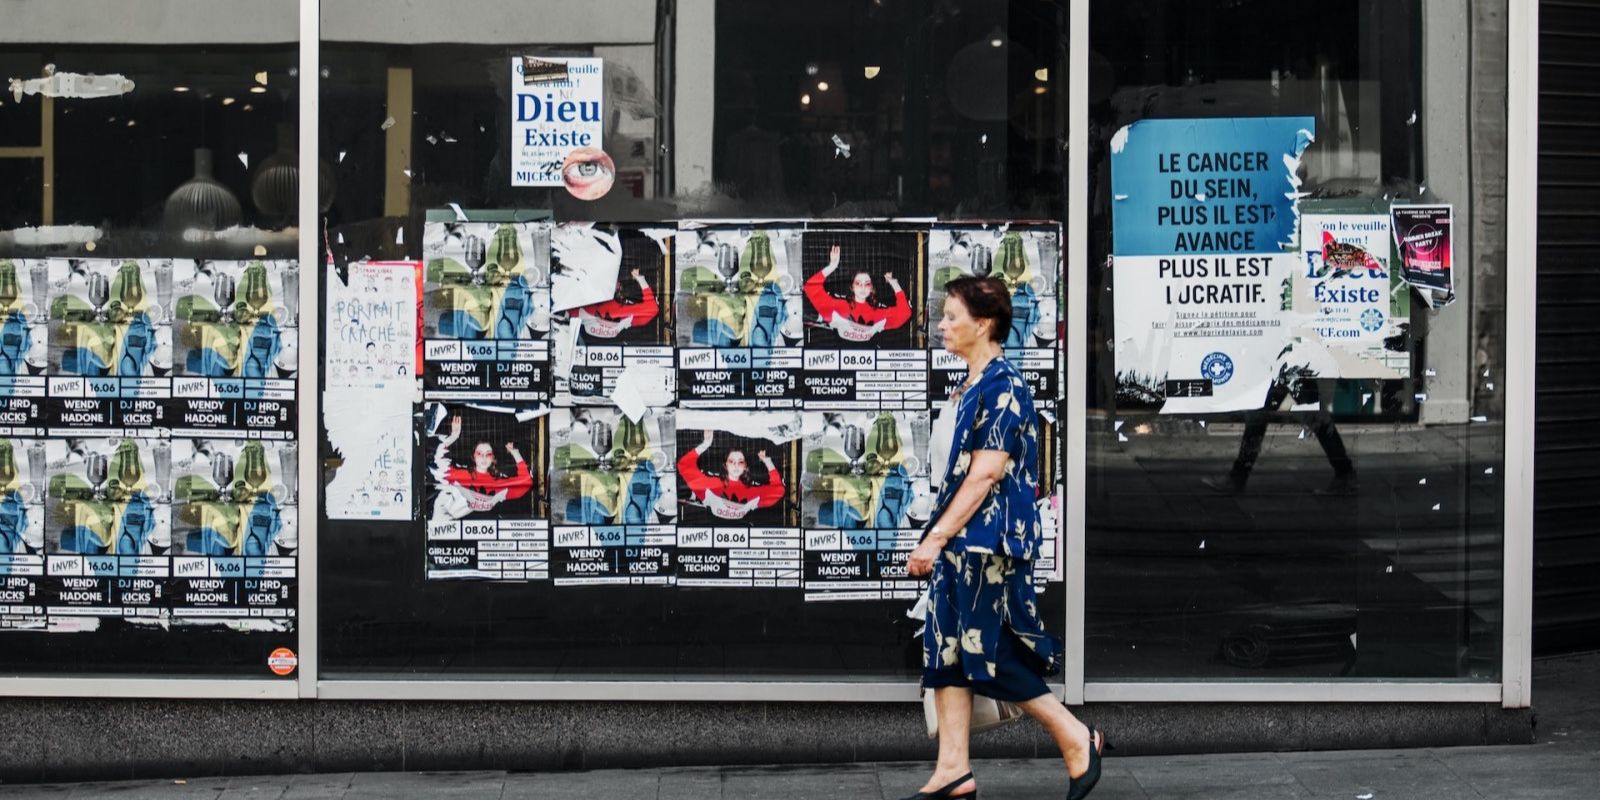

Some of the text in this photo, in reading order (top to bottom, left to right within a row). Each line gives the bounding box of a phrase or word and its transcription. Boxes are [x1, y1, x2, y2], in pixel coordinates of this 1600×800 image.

[568, 65, 599, 73] euille
[517, 93, 600, 122] Dieu
[526, 128, 591, 146] Existe
[1159, 152, 1268, 173] LE CANCER
[517, 171, 560, 182] MJCF.co
[1171, 179, 1258, 200] DU SEIN,
[1158, 205, 1272, 226] PLUS IL EST
[1340, 221, 1386, 230] le veuille
[1175, 231, 1255, 252] AVANCE
[1415, 239, 1432, 247] PARTY
[1159, 257, 1273, 278] PLUS IL EST
[337, 300, 405, 321] PORTRAIT
[430, 344, 456, 356] LNVRS
[466, 346, 492, 355] 16.06
[590, 353, 619, 361] 08.06
[684, 352, 711, 366] LNVRS
[721, 355, 746, 363] 16.06
[808, 353, 835, 366] LNVRS
[844, 356, 872, 365] 08.06
[441, 364, 477, 372] WENDY
[512, 364, 533, 372] HRD
[695, 372, 732, 380] WENDY
[752, 371, 788, 379] DJ HRD
[438, 377, 480, 385] HADONE
[500, 377, 529, 385] KICKS
[54, 381, 80, 394] LNVRS
[90, 383, 116, 392] 16.06
[178, 381, 204, 394] LNVRS
[214, 384, 240, 393] 16.06
[692, 385, 735, 394] HADONE
[755, 385, 784, 393] KICKS
[64, 400, 101, 409] WENDY
[120, 401, 156, 410] DJ HRD
[188, 400, 224, 410] WENDY
[259, 402, 279, 411] HRD
[62, 413, 103, 422] HADONE
[123, 414, 152, 423] KICKS
[185, 414, 227, 424] HADONE
[247, 416, 276, 425] KICKS
[434, 523, 456, 536] NVRS
[465, 526, 494, 534] 08.06
[558, 530, 584, 543] LNVRS
[595, 532, 620, 541] 16.06
[682, 531, 708, 544] LNVRS
[717, 534, 745, 542] 08.06
[810, 534, 836, 547] LNVRS
[846, 536, 872, 544] 16.06
[569, 550, 606, 558] WENDY
[821, 553, 857, 562] WENDY
[877, 553, 889, 561] DJ
[52, 559, 79, 572] LNVRS
[88, 562, 114, 571] 16.06
[178, 560, 205, 574] LNVRS
[214, 563, 240, 572] 16.06
[567, 563, 609, 572] HADONE
[629, 562, 658, 570] KICKS
[818, 566, 860, 575] HADONE
[880, 567, 909, 575] KICKS
[7, 578, 28, 586] HRD
[63, 579, 99, 587] WENDY
[133, 580, 154, 588] HRD
[189, 580, 225, 589] WENDY
[260, 581, 280, 589] HRD
[60, 592, 102, 601] HADONE
[122, 593, 151, 601] KICKS
[186, 594, 229, 602] HADONE
[248, 594, 277, 602] KICKS
